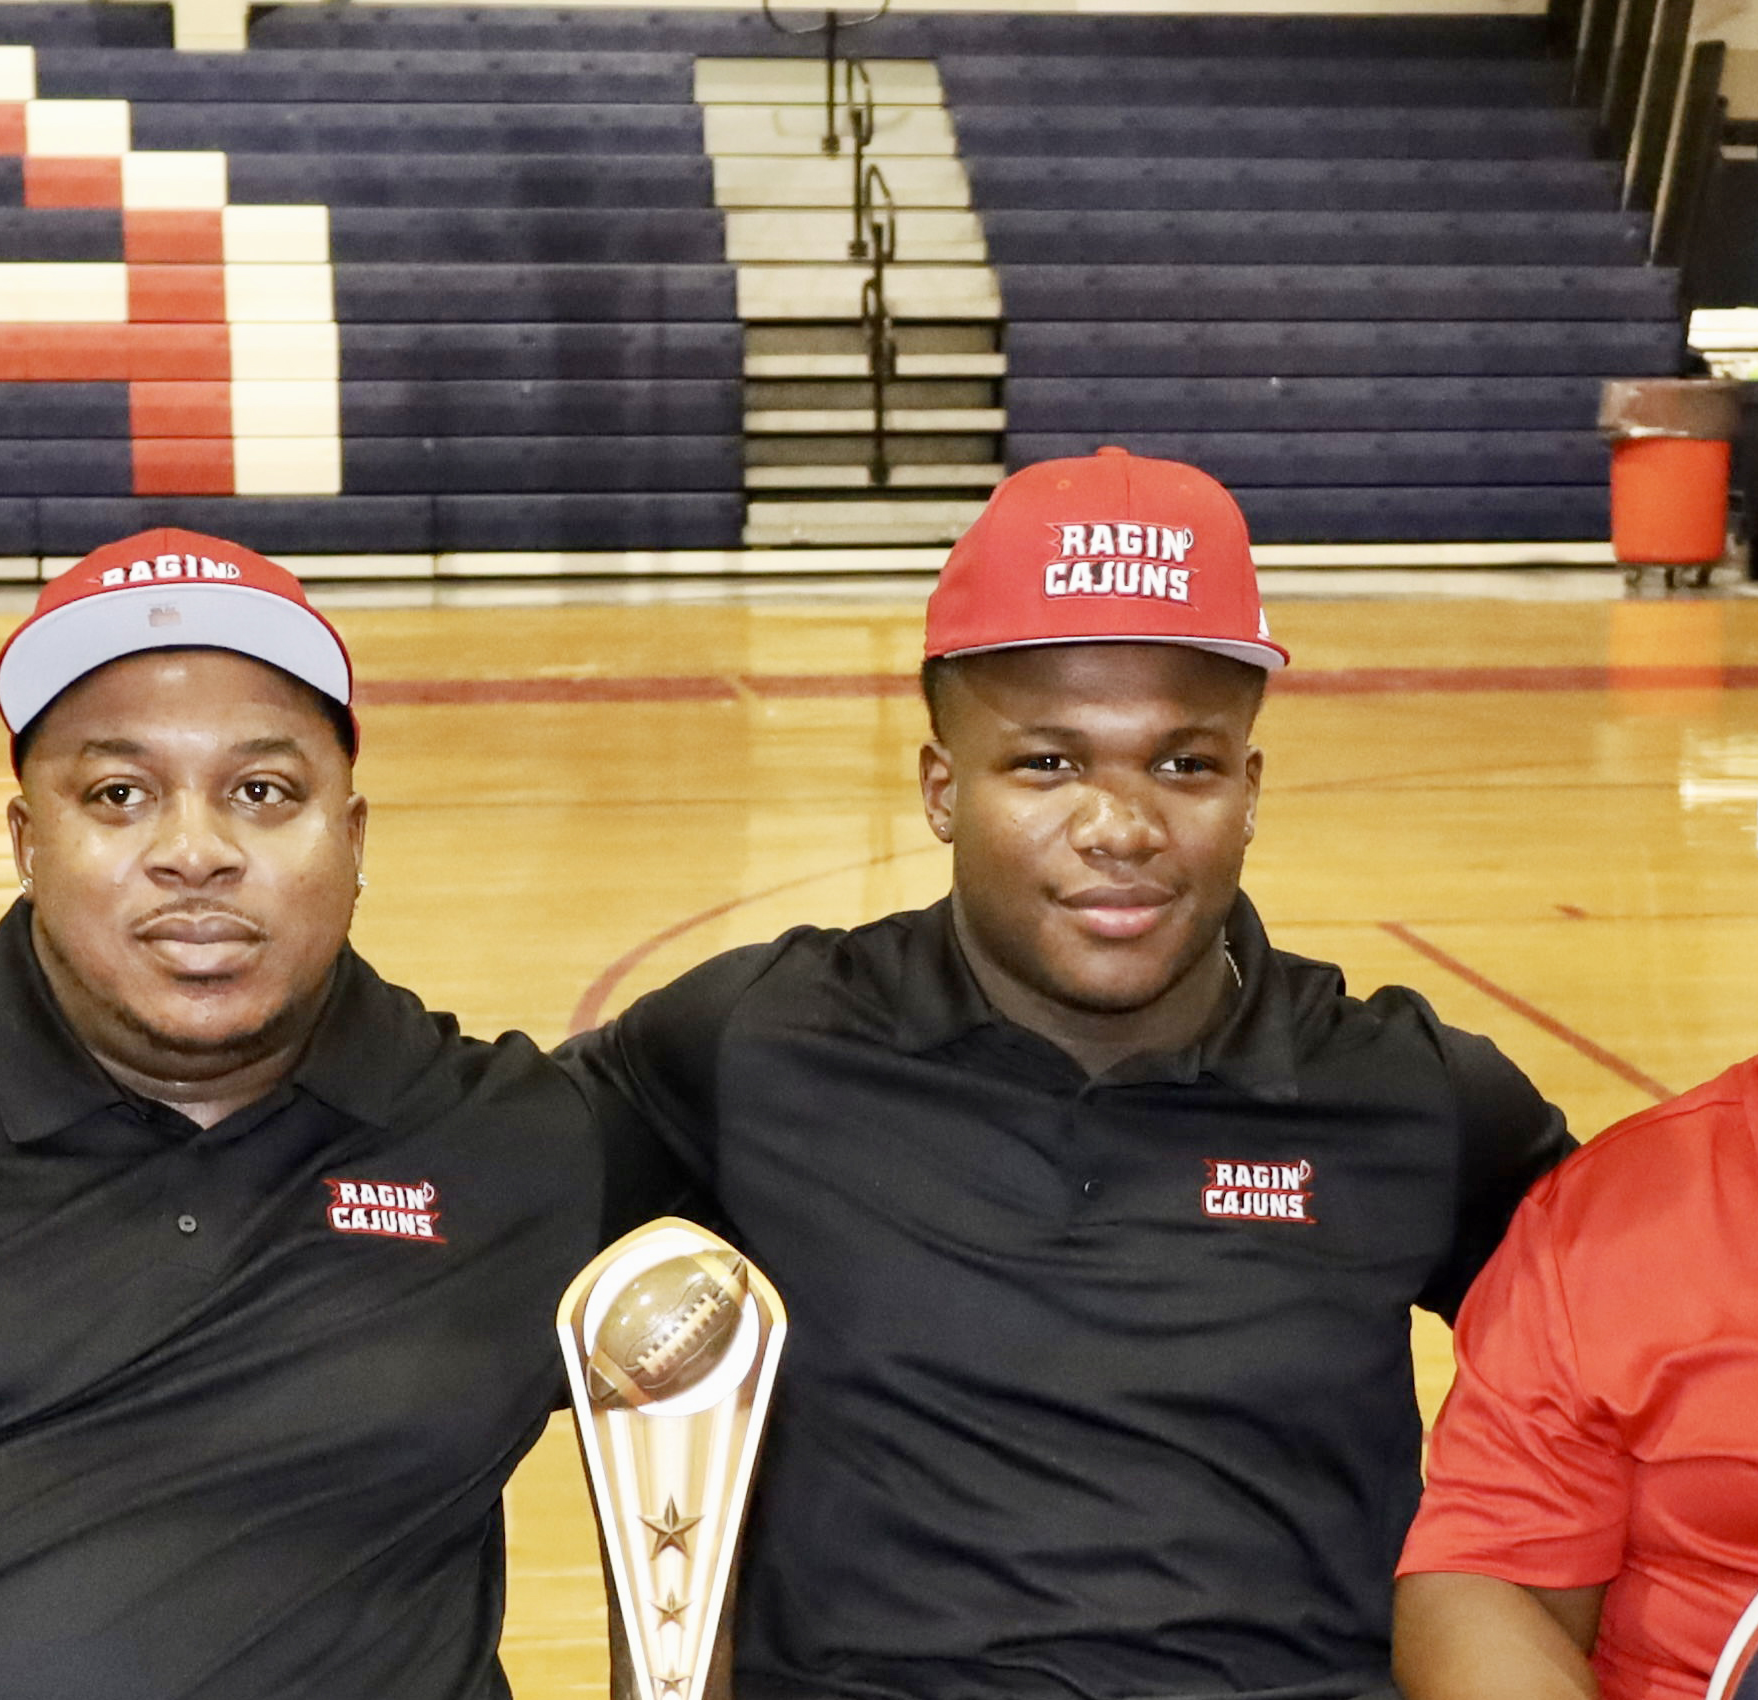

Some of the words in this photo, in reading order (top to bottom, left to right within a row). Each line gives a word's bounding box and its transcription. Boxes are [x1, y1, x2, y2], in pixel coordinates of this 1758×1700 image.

[1061, 523, 1193, 563] RAGIN'
[1045, 560, 1190, 601] CAJUNS
[1216, 1159, 1311, 1190] RAGIN'
[339, 1181, 435, 1210] RAGIN'
[1205, 1189, 1306, 1219] CAJUNS
[331, 1206, 433, 1237] CAJUNS
